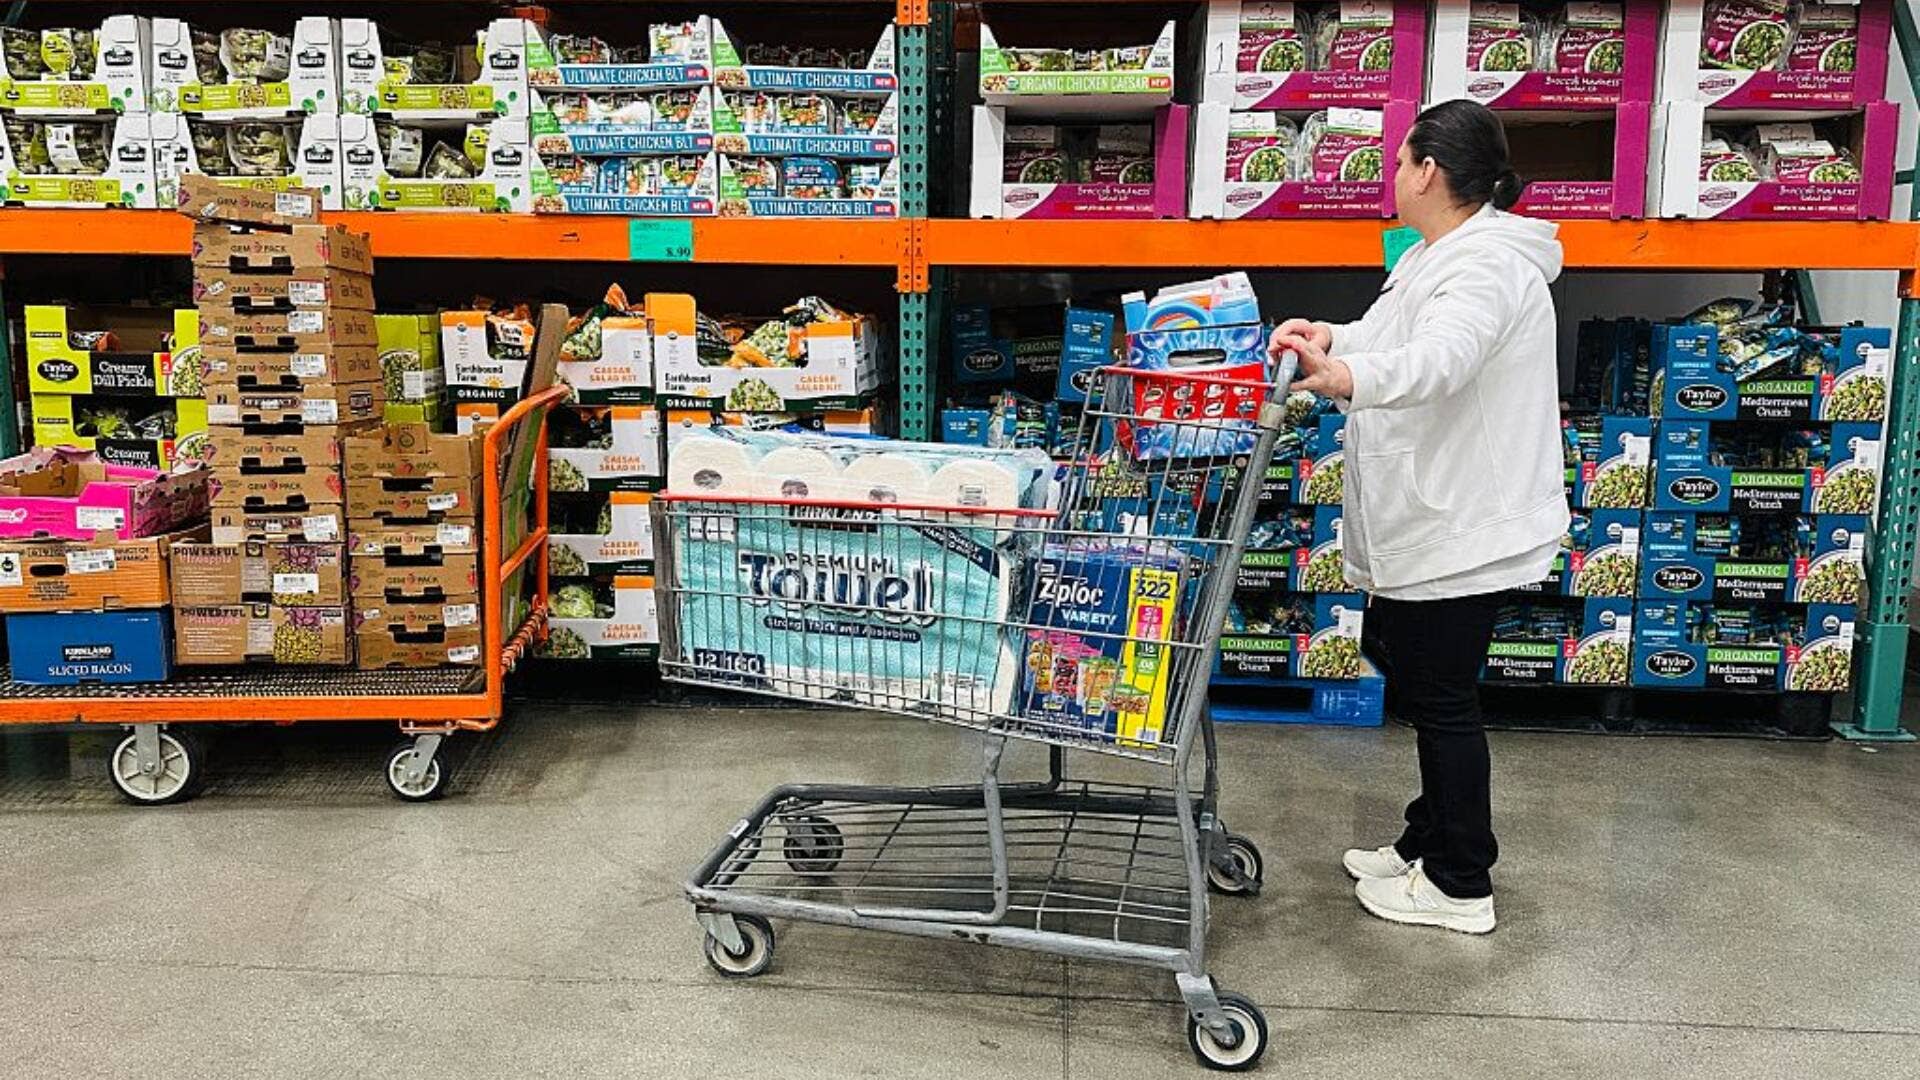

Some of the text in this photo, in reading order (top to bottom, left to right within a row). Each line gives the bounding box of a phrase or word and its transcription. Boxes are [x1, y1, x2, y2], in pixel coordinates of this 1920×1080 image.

[617, 68, 662, 82] CHICKEN
[805, 73, 850, 87] CHICKEN
[1019, 76, 1148, 90] ORGANIC CHICKEN CAESAR
[627, 136, 672, 149] CHICKEN
[805, 139, 850, 152] CHICKEN
[622, 199, 668, 211] CHICKEN
[807, 202, 851, 214] CHICKEN
[42, 363, 74, 373] Taylor
[99, 361, 147, 375] Creamy
[456, 364, 503, 374] Earthbound
[93, 375, 154, 387] Dill Pickle
[456, 373, 477, 382] Farm
[665, 373, 711, 383] Earthbound
[665, 382, 686, 391] Farm
[1746, 382, 1807, 393] ORGANIC
[457, 389, 505, 398] ORGANIC
[1684, 390, 1722, 401] Taylor
[666, 399, 713, 408] ORGANIC
[1741, 397, 1809, 408] Mediterranean
[1756, 408, 1791, 418] Crunch
[104, 447, 150, 460] Creamy
[1739, 474, 1798, 486] ORGANIC
[1678, 482, 1713, 493] Taylor
[1733, 488, 1800, 500] Mediterranean
[1748, 500, 1782, 509] Crunch
[174, 547, 239, 556] POWERFUL
[1241, 553, 1284, 565] GANIC
[1722, 565, 1782, 576] ORGANIC
[1661, 571, 1697, 582] Taylor
[741, 554, 934, 614] Towel
[1135, 579, 1171, 599] 322
[1717, 578, 1784, 589] Mediterranean
[1039, 577, 1104, 608] Ziploc
[1732, 589, 1766, 599] Crunch
[180, 609, 246, 617] POWERFUL
[1061, 609, 1117, 626] VARIETY
[1228, 639, 1283, 650] ORGANIC
[1494, 645, 1550, 655] ORGANIC
[65, 646, 112, 656] KIRKLAND
[1715, 651, 1774, 661] ORGANIC
[698, 652, 717, 668] 12
[1223, 652, 1287, 663] Mediterranean
[1653, 657, 1690, 668] Taylor
[1238, 661, 1271, 672] Crunch
[1487, 658, 1553, 669] Mediterranean
[48, 663, 132, 676] SLICED BACON
[1503, 668, 1537, 678] Crunch
[1709, 665, 1775, 676] Mediterranean
[1724, 675, 1758, 684] Crunch
